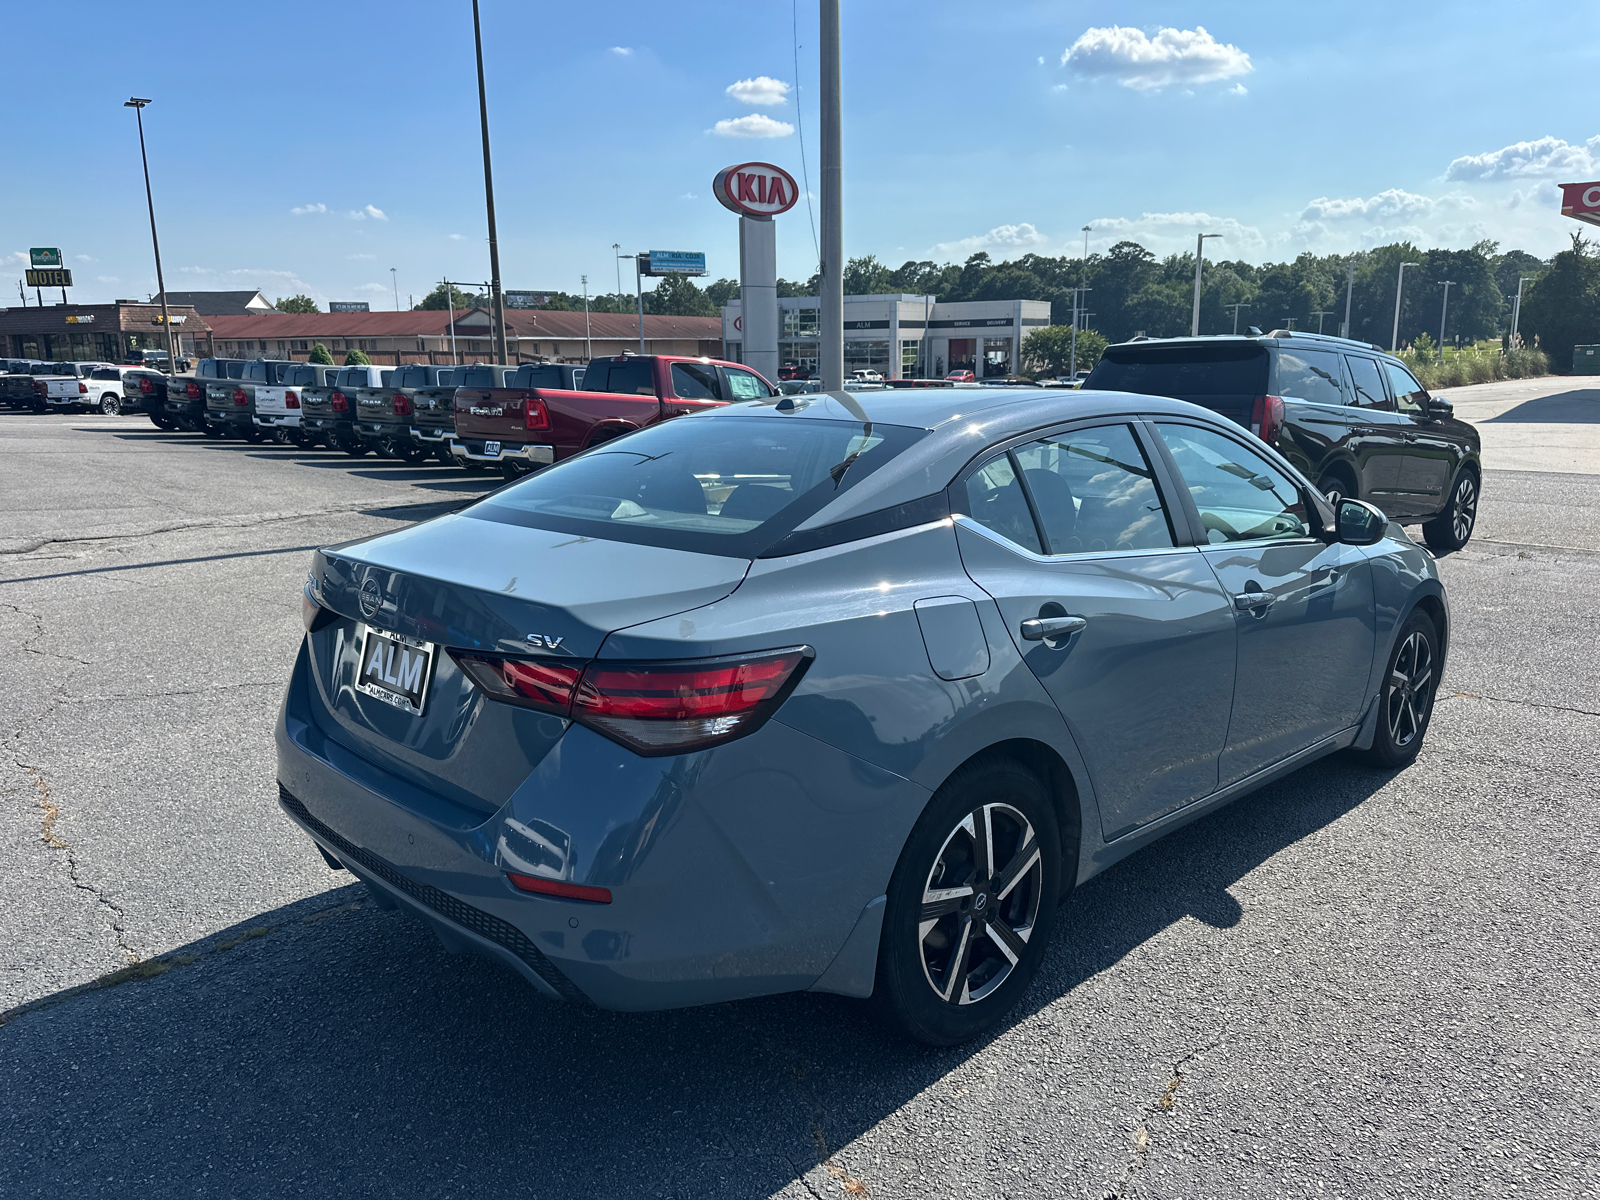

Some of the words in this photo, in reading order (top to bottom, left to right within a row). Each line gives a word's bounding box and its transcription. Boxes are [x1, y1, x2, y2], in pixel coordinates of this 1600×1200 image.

[737, 172, 787, 206] KIA
[27, 271, 69, 285] MOTEL
[157, 315, 187, 324] SBWAY
[470, 407, 503, 416] RAM
[486, 444, 500, 453] ALM
[526, 633, 564, 649] SV
[365, 641, 424, 694] ALM
